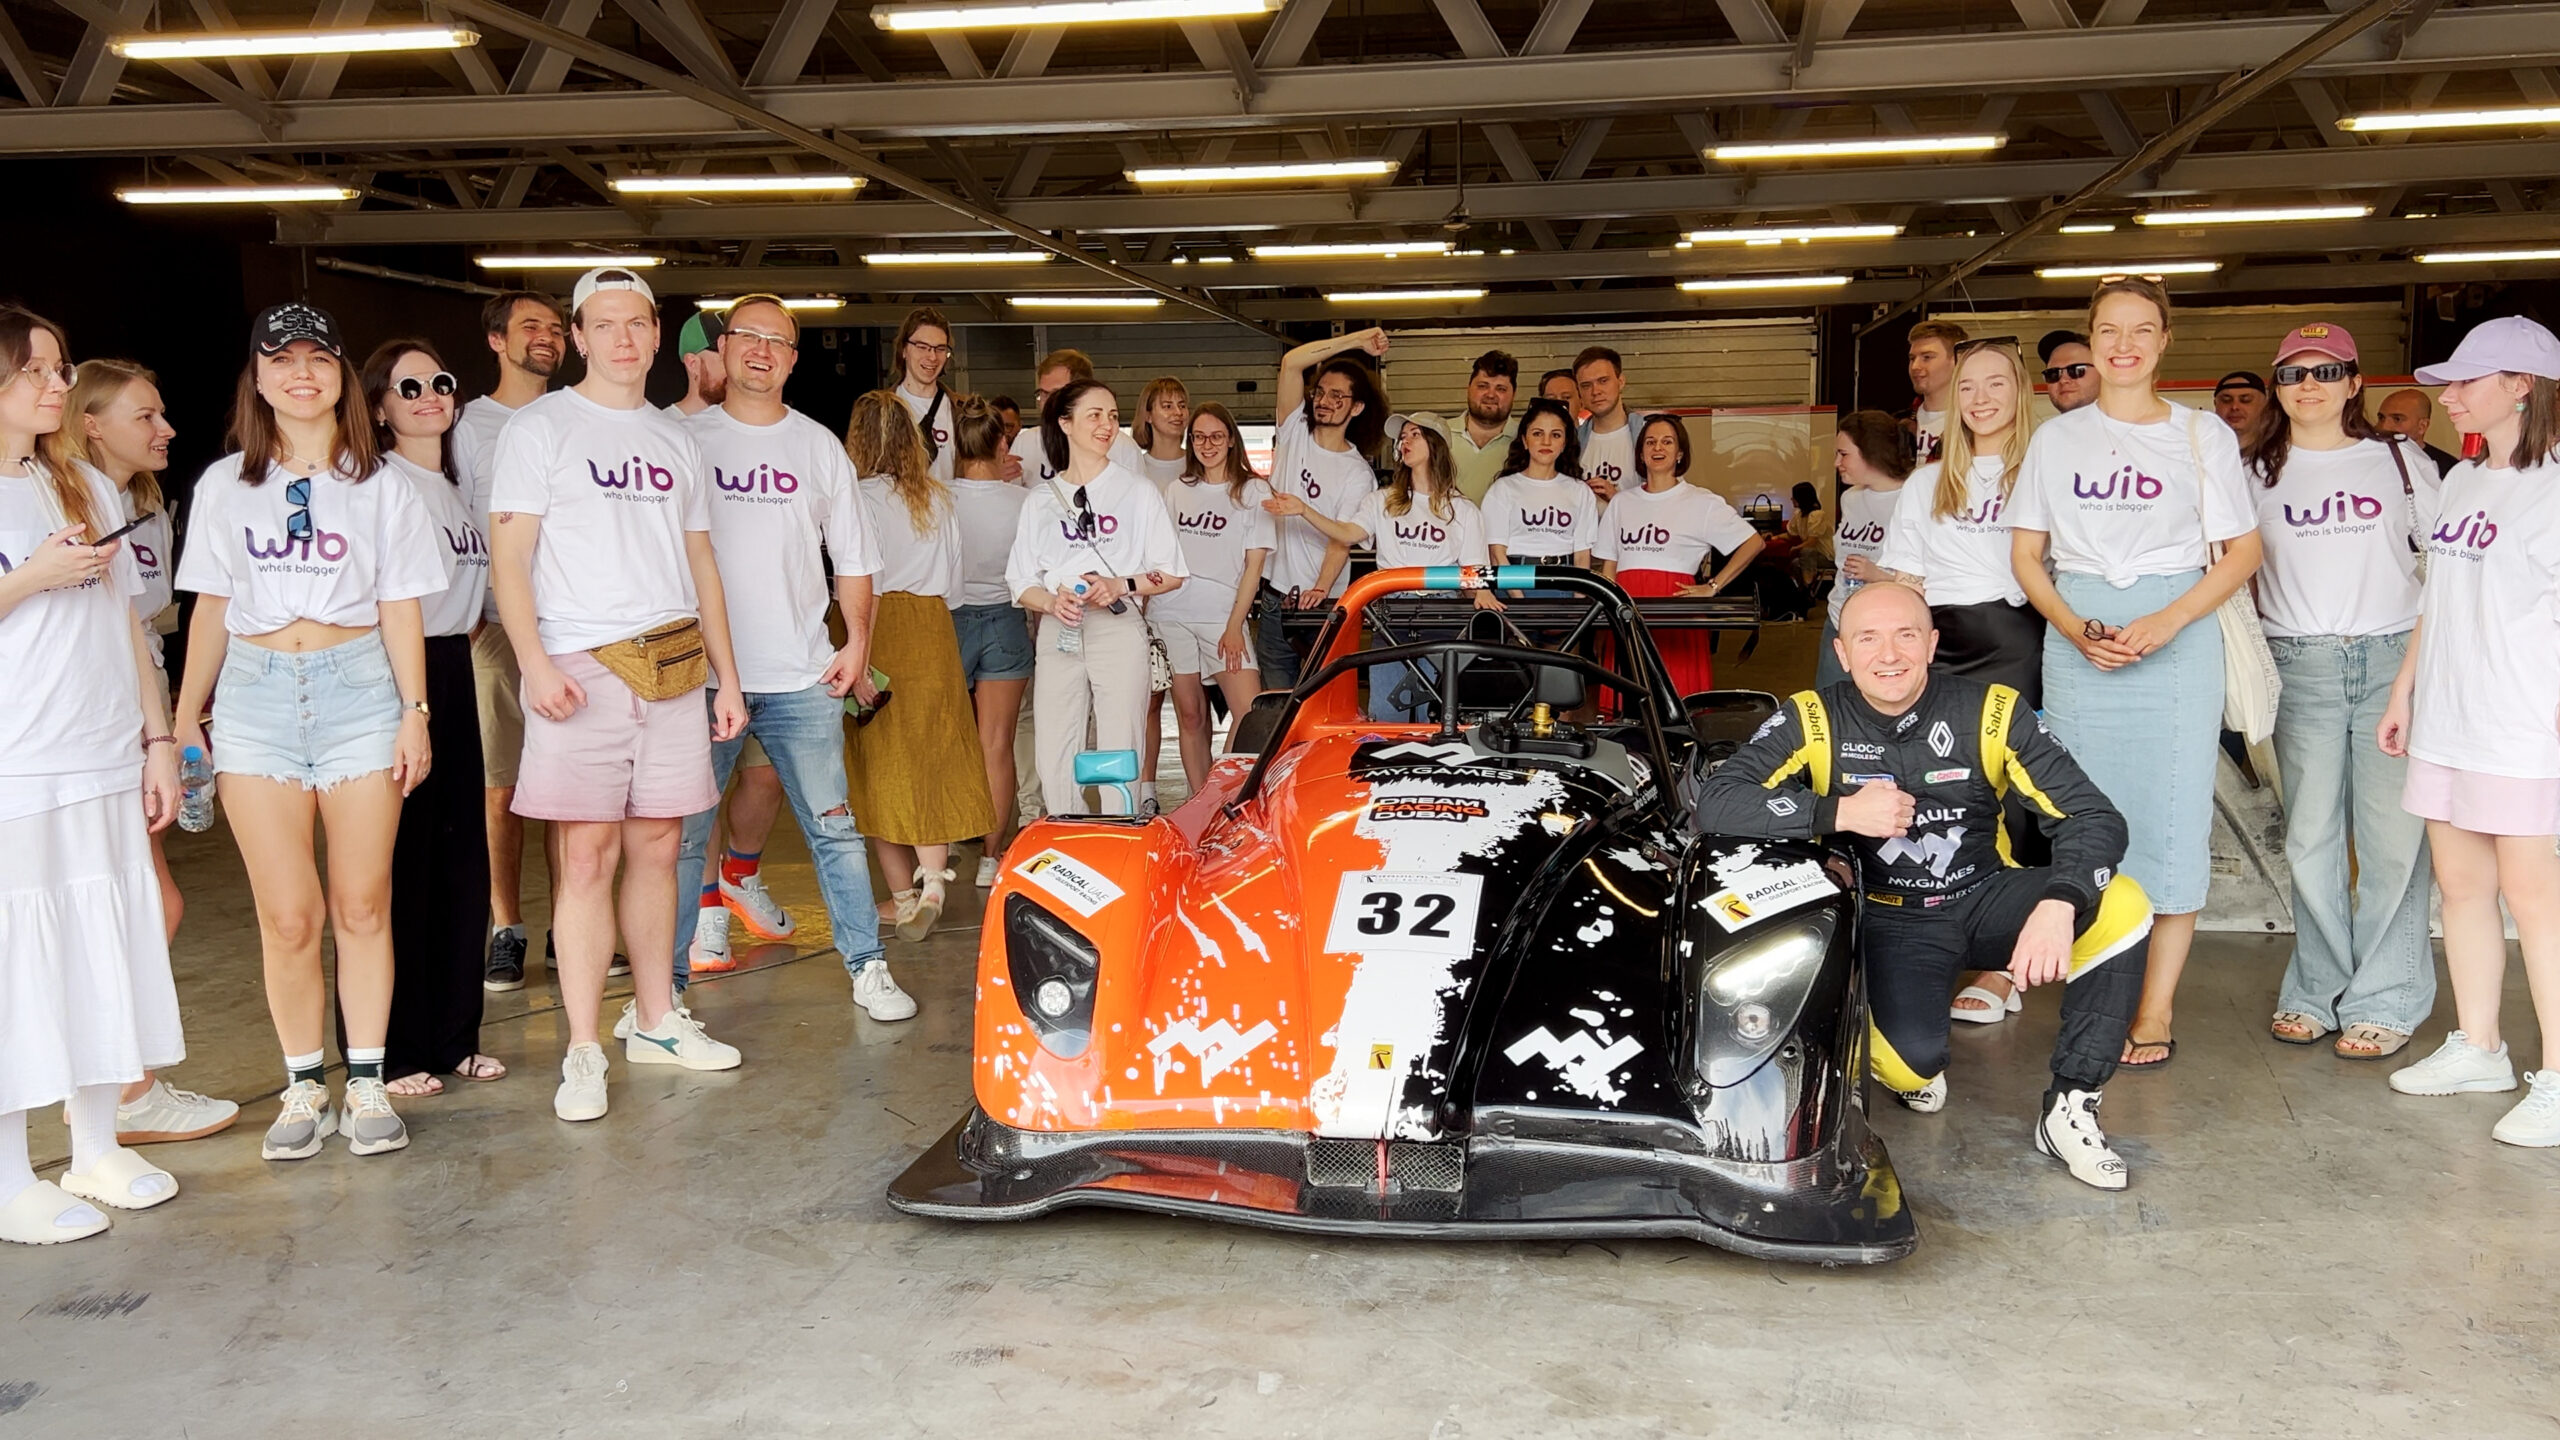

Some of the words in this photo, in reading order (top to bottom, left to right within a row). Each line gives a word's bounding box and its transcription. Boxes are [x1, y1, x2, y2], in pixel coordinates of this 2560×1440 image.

[587, 456, 673, 491] wib
[714, 463, 798, 494] wib
[2074, 465, 2163, 500] wib
[603, 491, 622, 500] who
[633, 494, 669, 504] blogger
[724, 493, 745, 502] who
[747, 495, 755, 503] is
[757, 496, 793, 505] blogger
[2079, 502, 2102, 511] who
[2105, 503, 2113, 511] is
[2116, 503, 2154, 512] blogger
[1521, 506, 1572, 527] wib
[1952, 494, 2003, 524] wi
[2283, 491, 2382, 527] wib
[1178, 511, 1227, 530] wib
[1956, 524, 1976, 533] who
[1978, 525, 1985, 533] is
[2295, 527, 2319, 538] who
[2334, 523, 2376, 534] blogger
[2431, 510, 2498, 550] wib
[1395, 521, 1446, 543] wib
[1620, 523, 1670, 544] wib
[1841, 521, 1884, 543] wib
[2428, 545, 2446, 555] who
[2448, 547, 2457, 556] is
[282, 561, 292, 573] is
[295, 563, 340, 576] blogger
[1805, 701, 1825, 742] Sabelt
[1986, 694, 2007, 738] Sabelt
[1365, 767, 1514, 780] MY.GAMES
[1377, 804, 1483, 815] RACING
[1379, 797, 1479, 807] DREAM
[1375, 811, 1463, 820] DUBAI
[1915, 808, 1967, 827] AULT
[1051, 864, 1090, 889] RADICAL
[1088, 886, 1109, 901] UAE
[1746, 878, 1798, 902] RADICAL
[1797, 871, 1818, 883] UAE
[1357, 892, 1456, 938] 32
